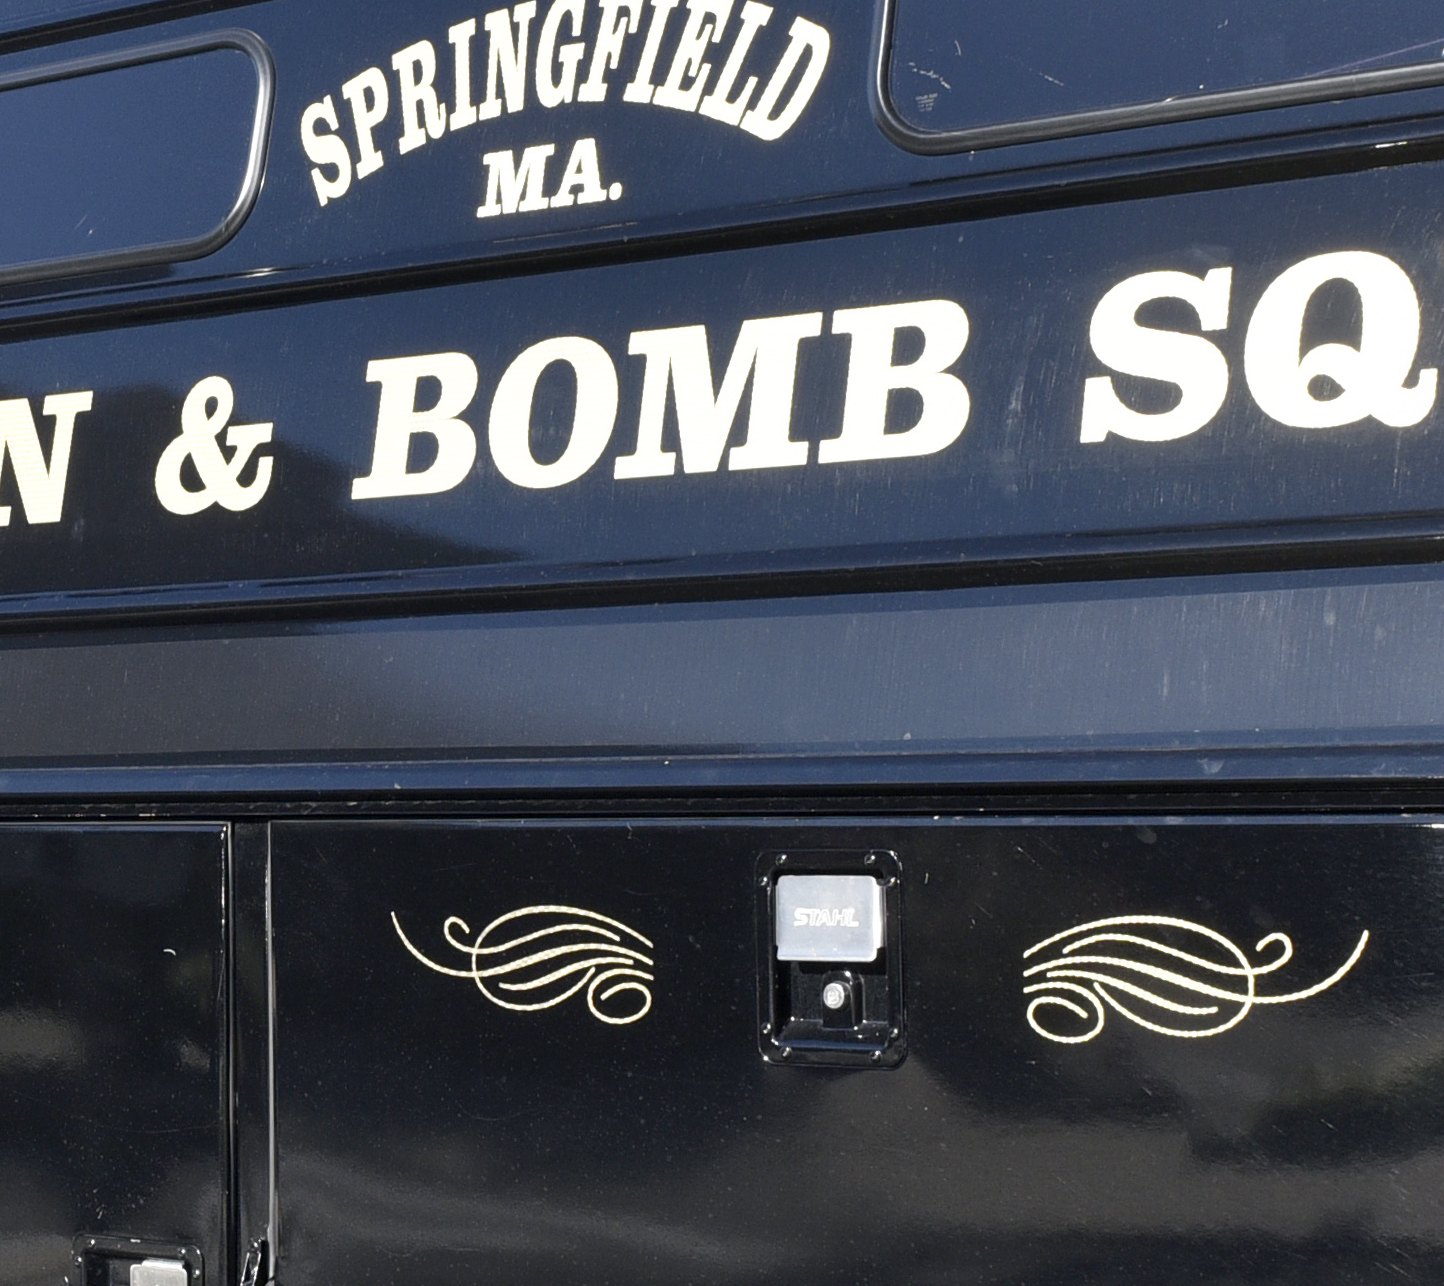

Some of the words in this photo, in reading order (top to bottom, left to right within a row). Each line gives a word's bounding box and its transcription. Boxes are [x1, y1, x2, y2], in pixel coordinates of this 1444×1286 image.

[476, 138, 623, 219] MA.
[153, 375, 274, 517] &
[350, 298, 973, 501] BOMB
[794, 907, 860, 927] STAHL
